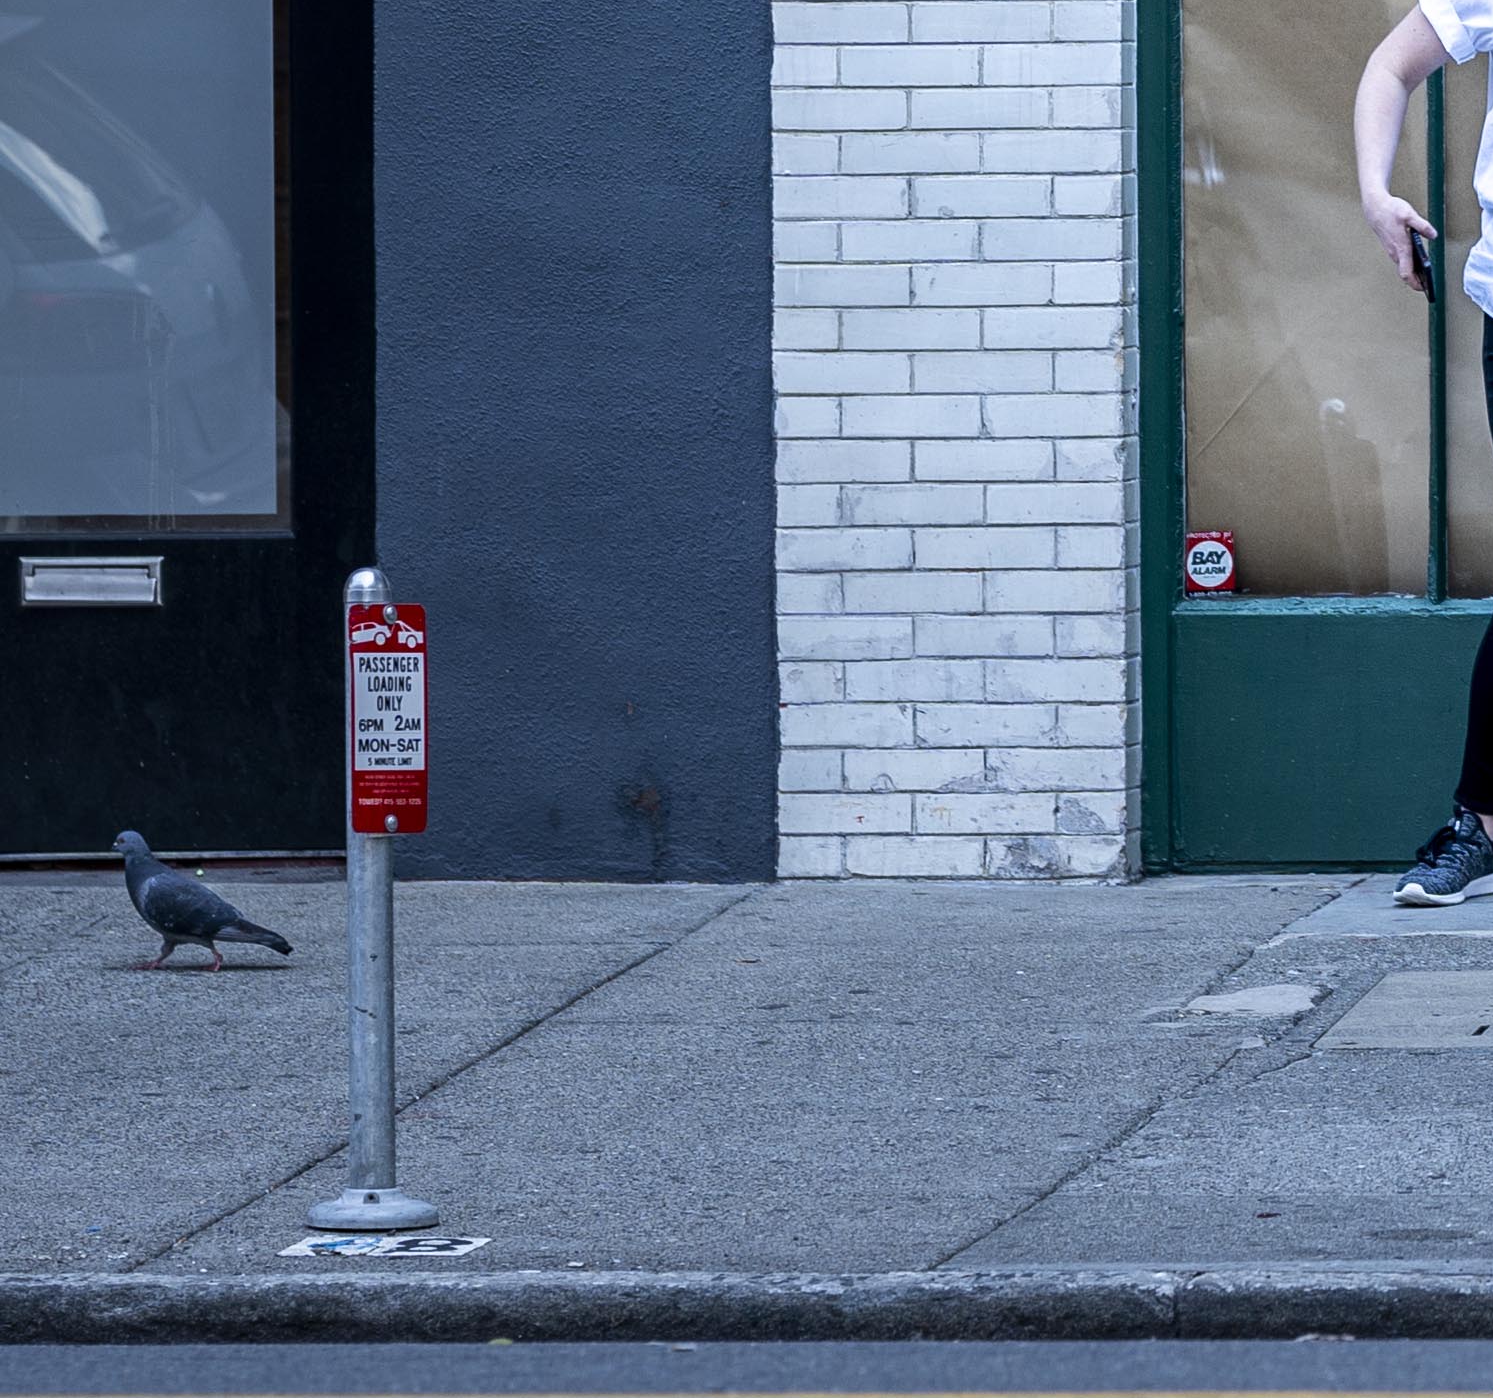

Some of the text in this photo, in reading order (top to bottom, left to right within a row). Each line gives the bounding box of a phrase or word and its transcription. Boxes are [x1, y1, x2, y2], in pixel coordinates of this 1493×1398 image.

[1191, 551, 1227, 565] BAY
[1191, 567, 1226, 575] ALARM
[358, 657, 419, 673] PASSENGER
[367, 676, 412, 692] LOADING
[376, 695, 403, 712] ONLY
[358, 714, 421, 732] 6PM 2AM
[358, 738, 421, 753] MON-SAT
[367, 757, 412, 766] 5 MINUTE LIMIT
